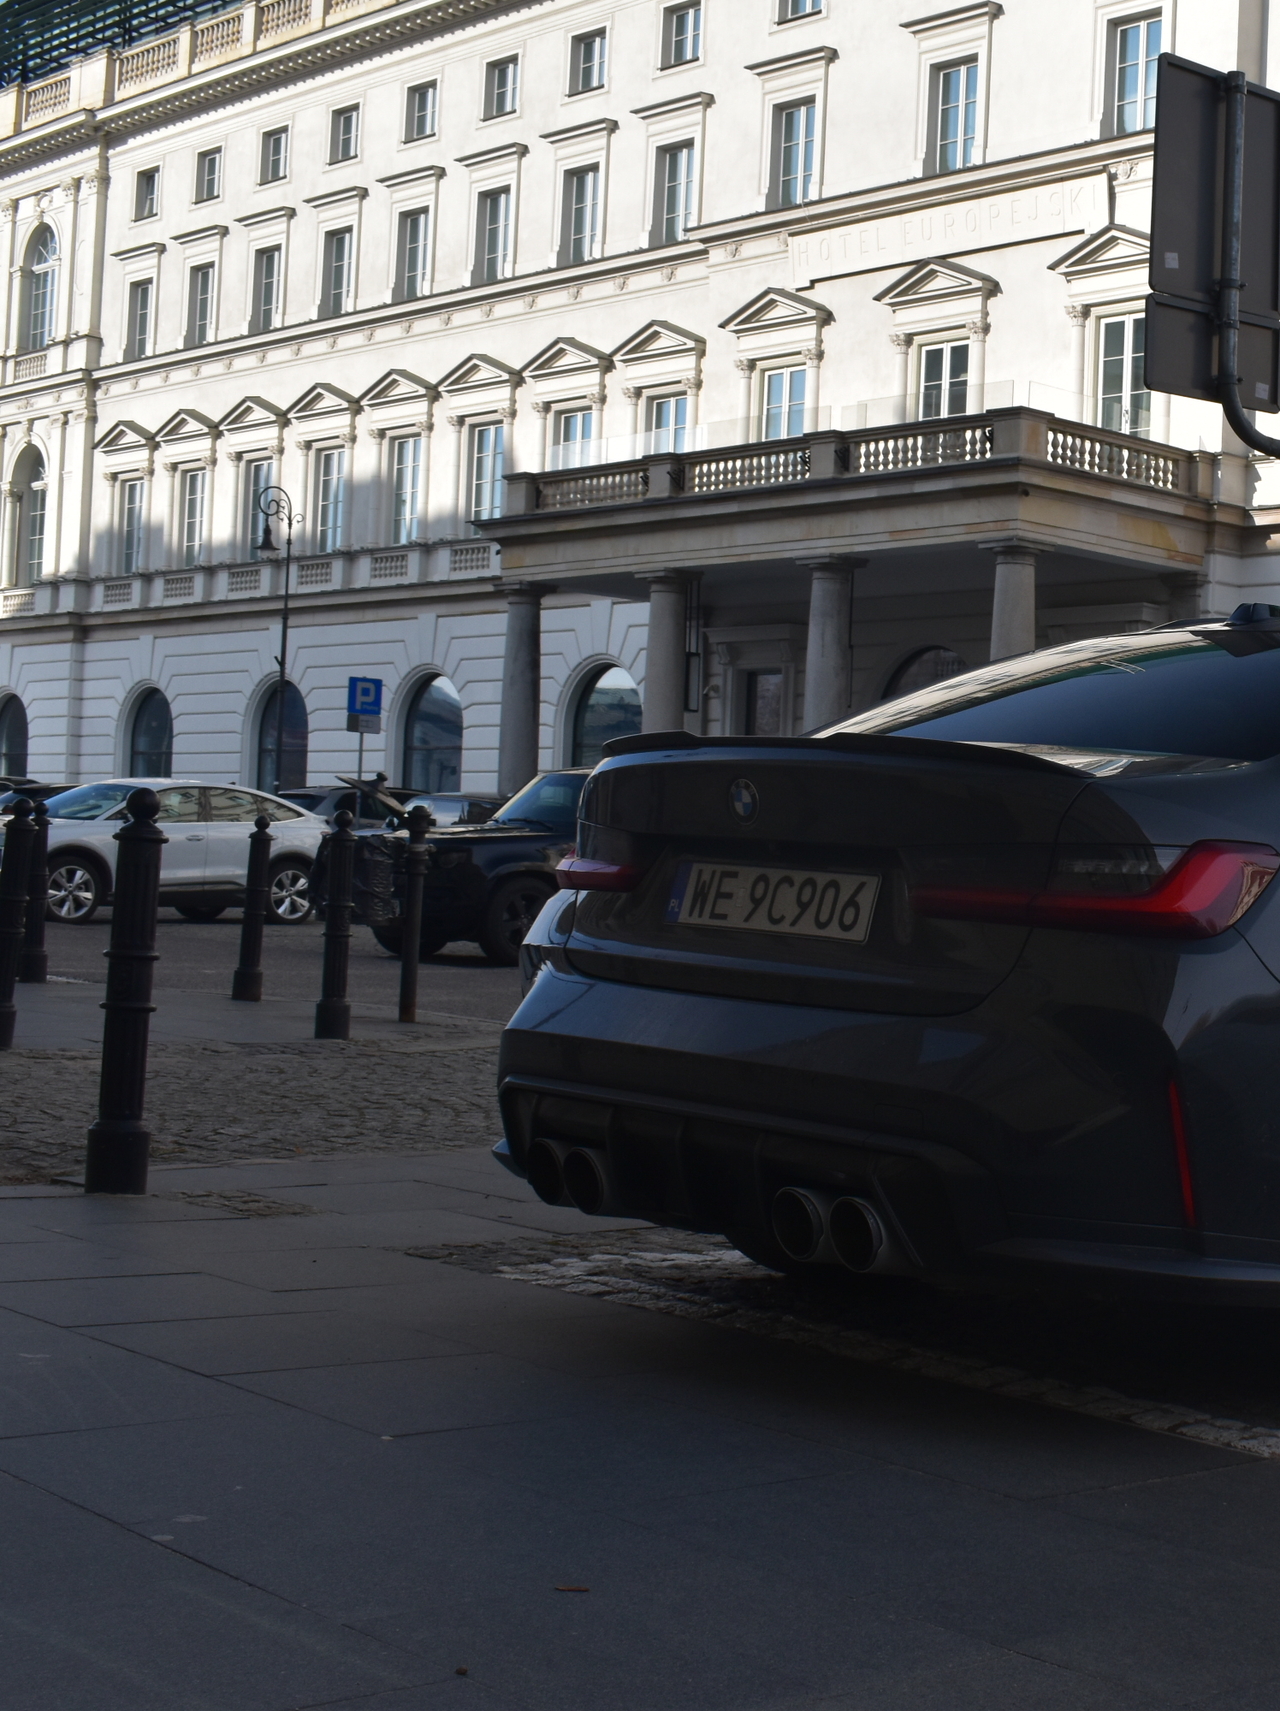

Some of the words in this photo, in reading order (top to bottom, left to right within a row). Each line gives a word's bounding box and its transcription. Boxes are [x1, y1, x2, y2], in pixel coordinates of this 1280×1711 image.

[798, 227, 887, 267] HOTEL
[903, 184, 1097, 247] EUROPEJSKI
[355, 681, 376, 710] P
[668, 899, 680, 912] PL
[688, 869, 739, 920] WE
[743, 873, 868, 932] 9C906
